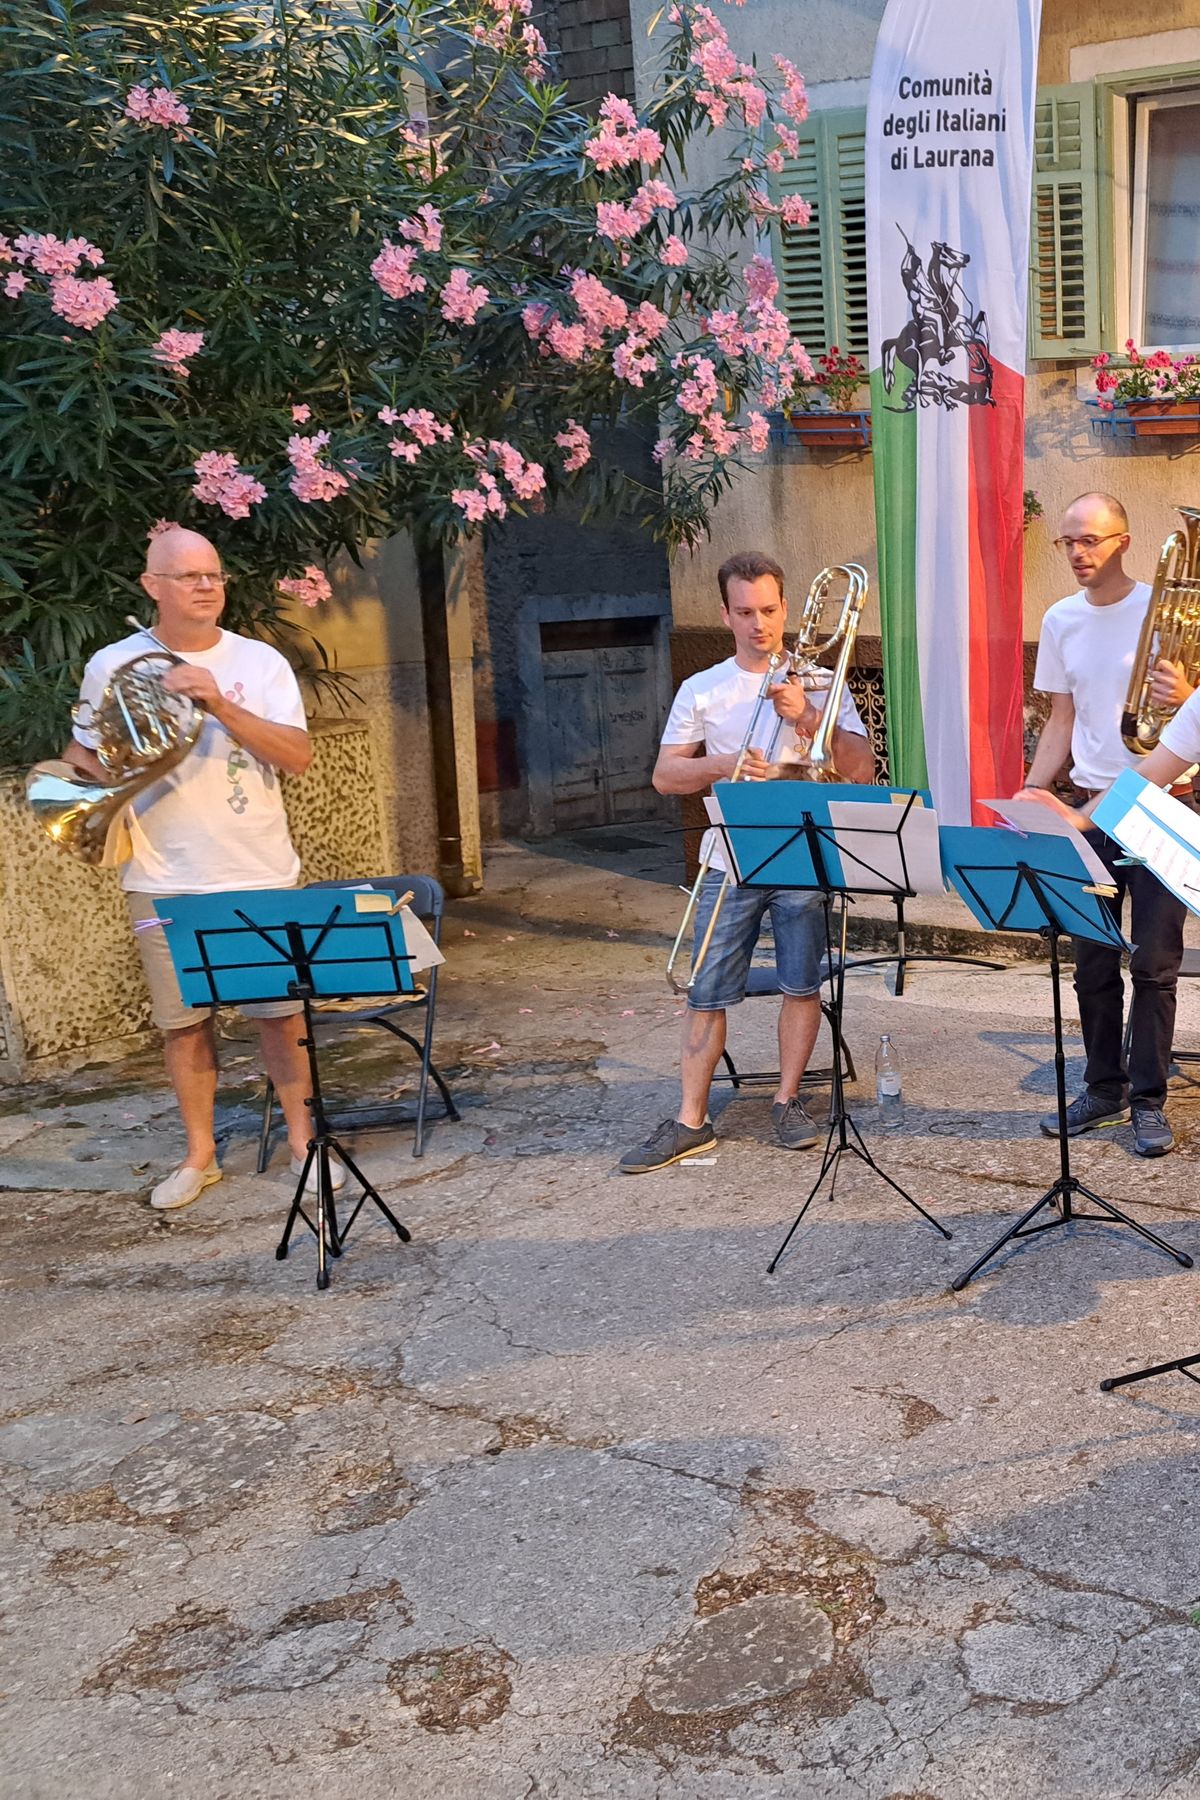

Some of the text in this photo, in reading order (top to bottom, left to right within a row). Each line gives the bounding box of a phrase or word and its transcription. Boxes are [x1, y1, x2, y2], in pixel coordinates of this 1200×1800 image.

[899, 69, 993, 100] Comunità
[883, 108, 1006, 140] degli Italiani
[891, 146, 994, 170] di Laurana
